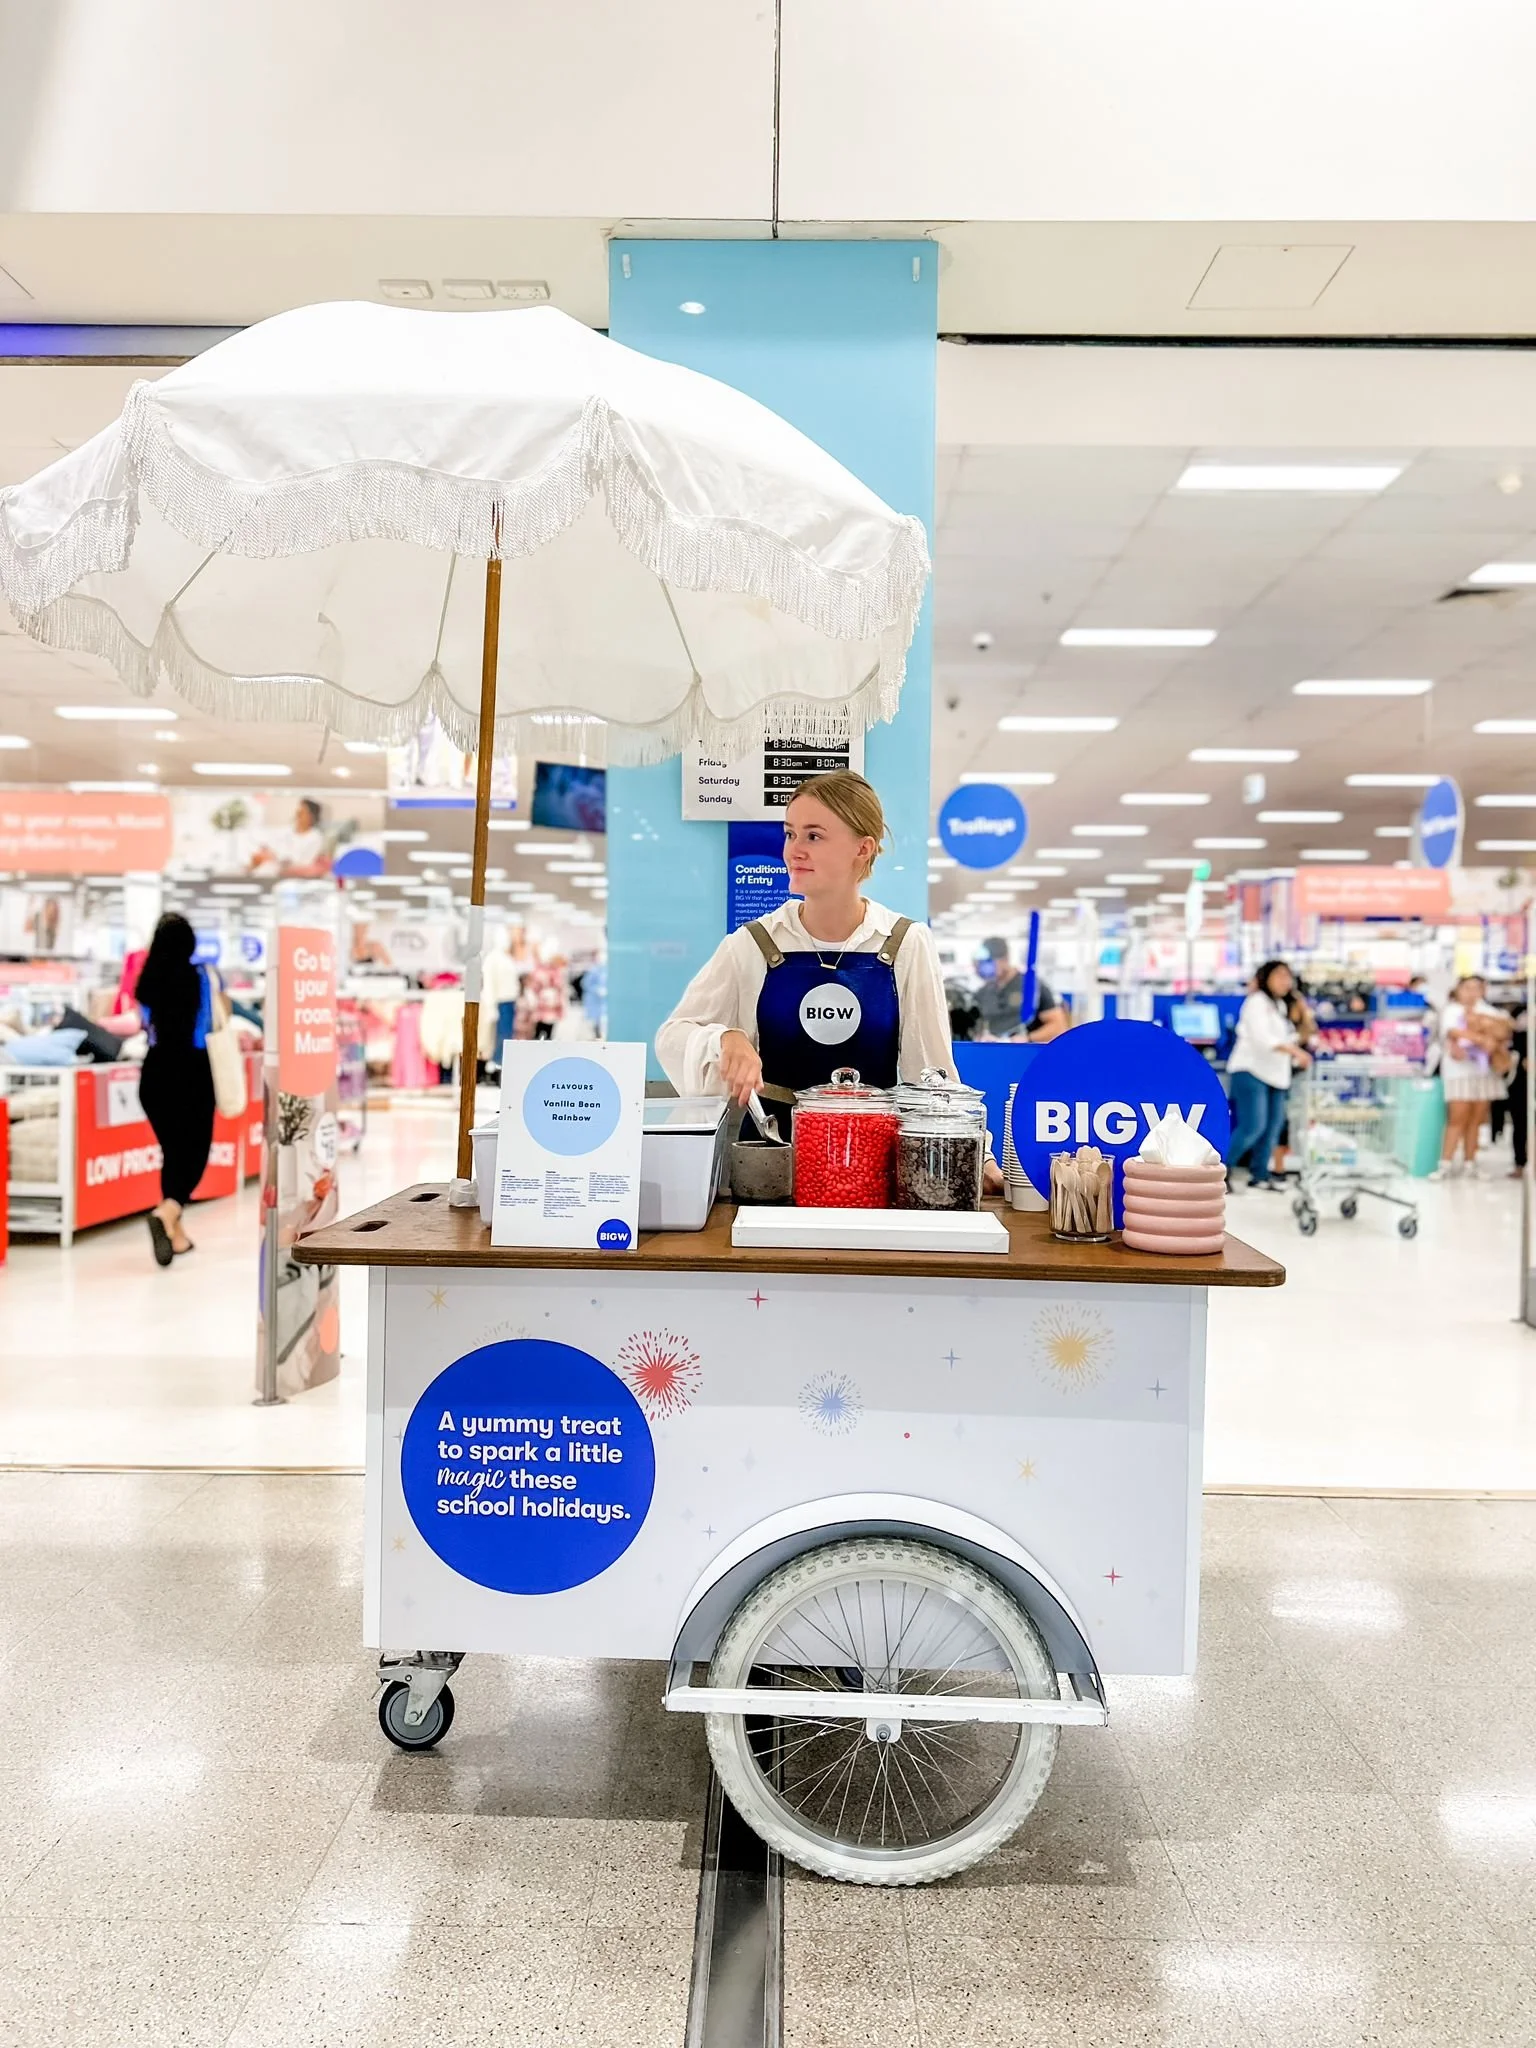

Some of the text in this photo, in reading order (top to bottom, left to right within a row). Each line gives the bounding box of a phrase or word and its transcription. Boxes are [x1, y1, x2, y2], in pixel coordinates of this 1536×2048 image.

[773, 758, 803, 767] 8:30am
[816, 758, 846, 769] 8:00pm
[698, 776, 740, 787] Saturday
[773, 776, 803, 785] 8:30am
[698, 794, 791, 805] Sunday 9:00
[735, 864, 787, 874] Conditions
[735, 875, 773, 887] of Entry
[294, 947, 318, 971] Go
[294, 980, 329, 1002] your
[543, 1100, 575, 1108] Vanilla
[552, 1114, 591, 1122] Rainbow
[86, 1153, 121, 1186] LOW
[438, 1411, 622, 1439] A yummy treat
[438, 1440, 623, 1465] to spark a little
[437, 1467, 577, 1499] magic these
[437, 1495, 631, 1525] school holidays.
